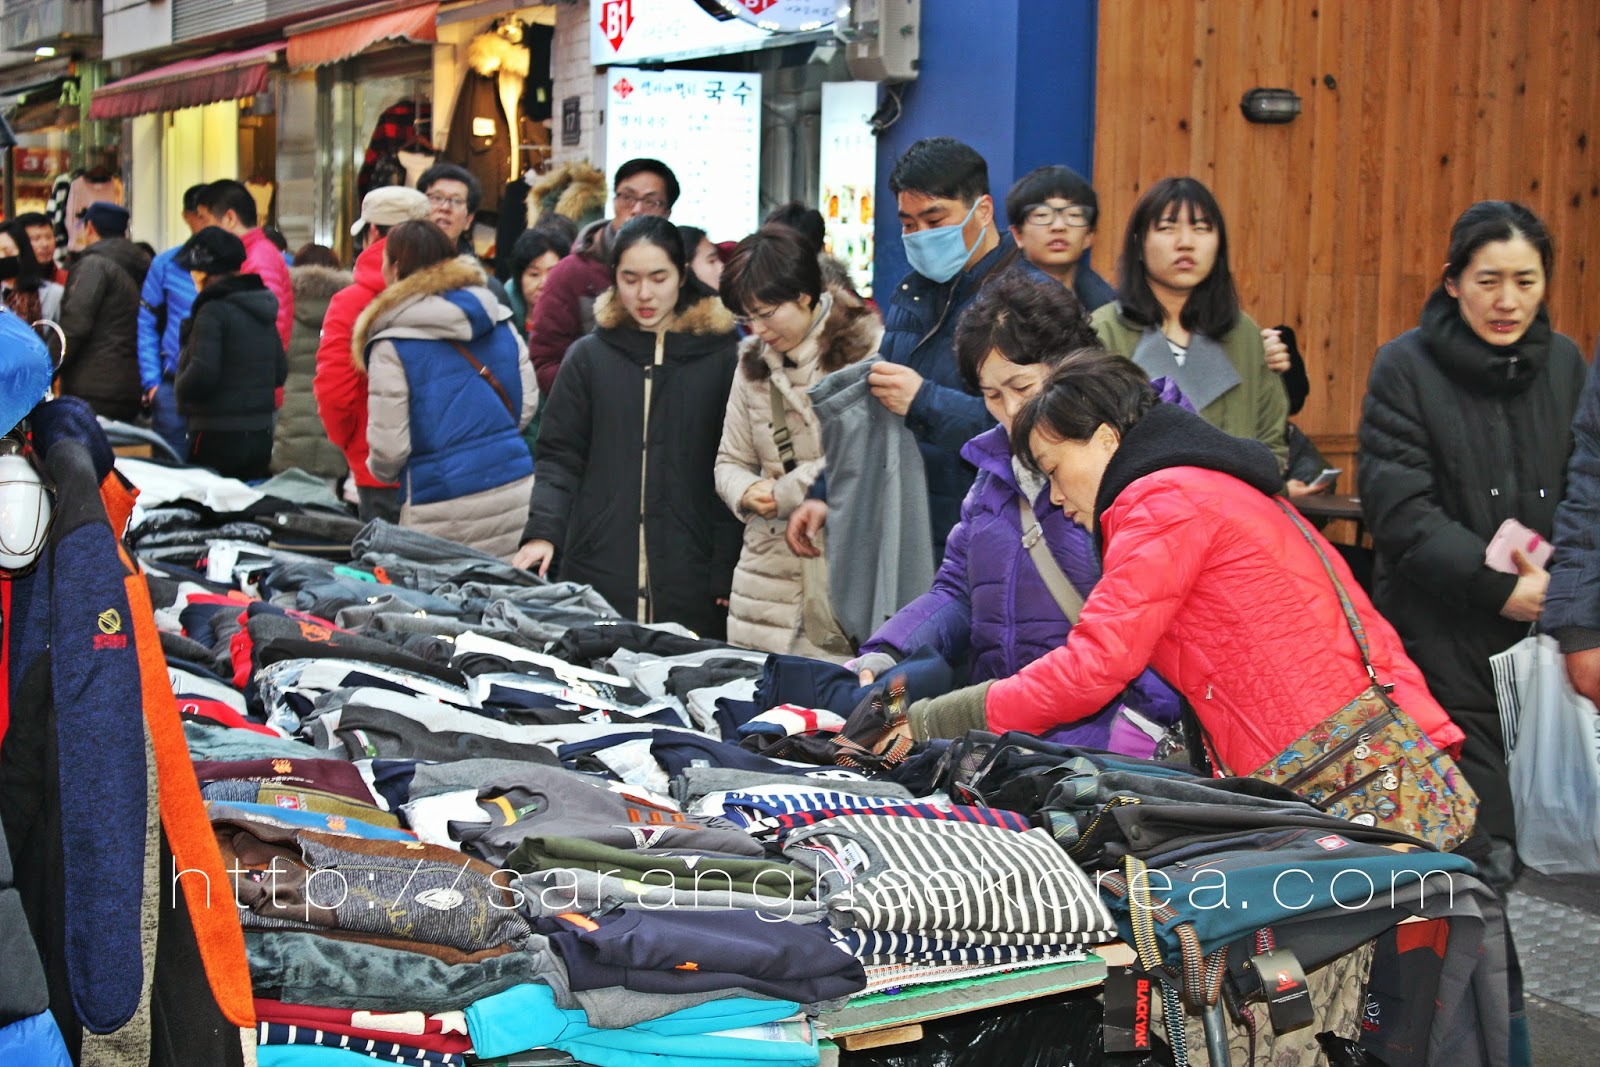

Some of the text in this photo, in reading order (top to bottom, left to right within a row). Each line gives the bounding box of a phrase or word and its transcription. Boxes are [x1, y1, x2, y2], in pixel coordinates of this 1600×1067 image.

[606, 0, 628, 40] B1
[704, 80, 753, 107] 국수
[1135, 979, 1150, 1048] BLACKYAK
